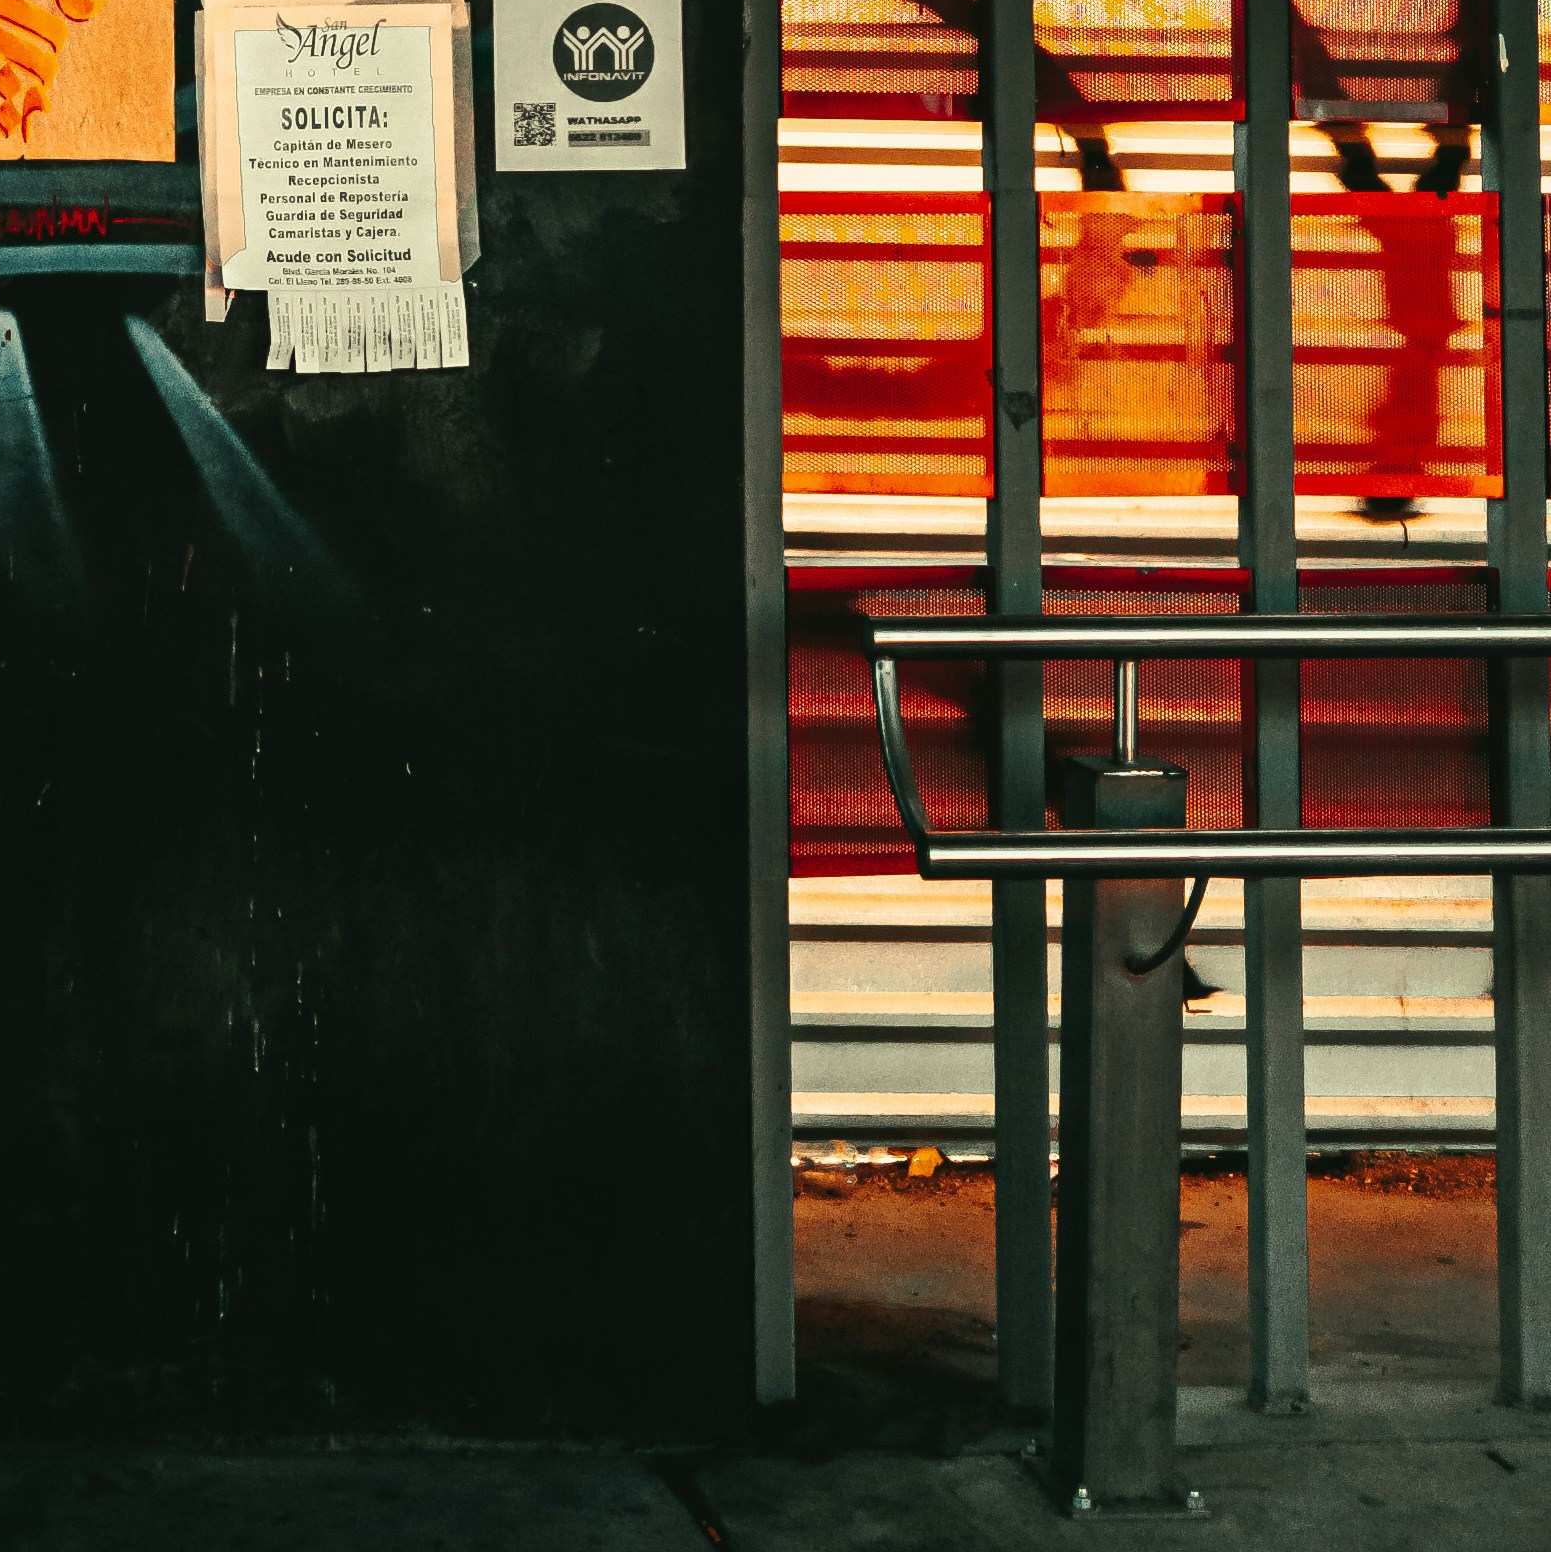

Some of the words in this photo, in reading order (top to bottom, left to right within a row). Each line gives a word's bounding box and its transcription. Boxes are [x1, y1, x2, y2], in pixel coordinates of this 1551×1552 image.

[321, 16, 347, 33] San
[288, 18, 387, 69] Angel
[285, 68, 382, 78] HOTEL
[563, 72, 645, 81] INFONAVIT
[255, 87, 292, 96] EMPRESA
[294, 87, 305, 95] EN
[307, 86, 356, 95] CONSTANTE
[358, 85, 413, 94] CRECIMIENTO
[281, 105, 389, 130] SOLICITA:
[567, 116, 642, 125] WATHASAPP
[273, 139, 322, 154] Capitán
[326, 139, 342, 150] de
[347, 139, 393, 149] Mesero
[303, 159, 319, 168] en
[323, 156, 418, 168] Mantenimiento
[288, 174, 380, 188] Recepcionista
[260, 192, 316, 204] Personal
[320, 192, 335, 203] de
[320, 209, 335, 220] de
[339, 208, 403, 223] Seguridad
[268, 227, 341, 239] Camaristas
[345, 229, 352, 241] y
[266, 250, 311, 263] Acude
[316, 251, 342, 263] con
[347, 248, 412, 263] Solicitud
[268, 277, 284, 285] Col.
